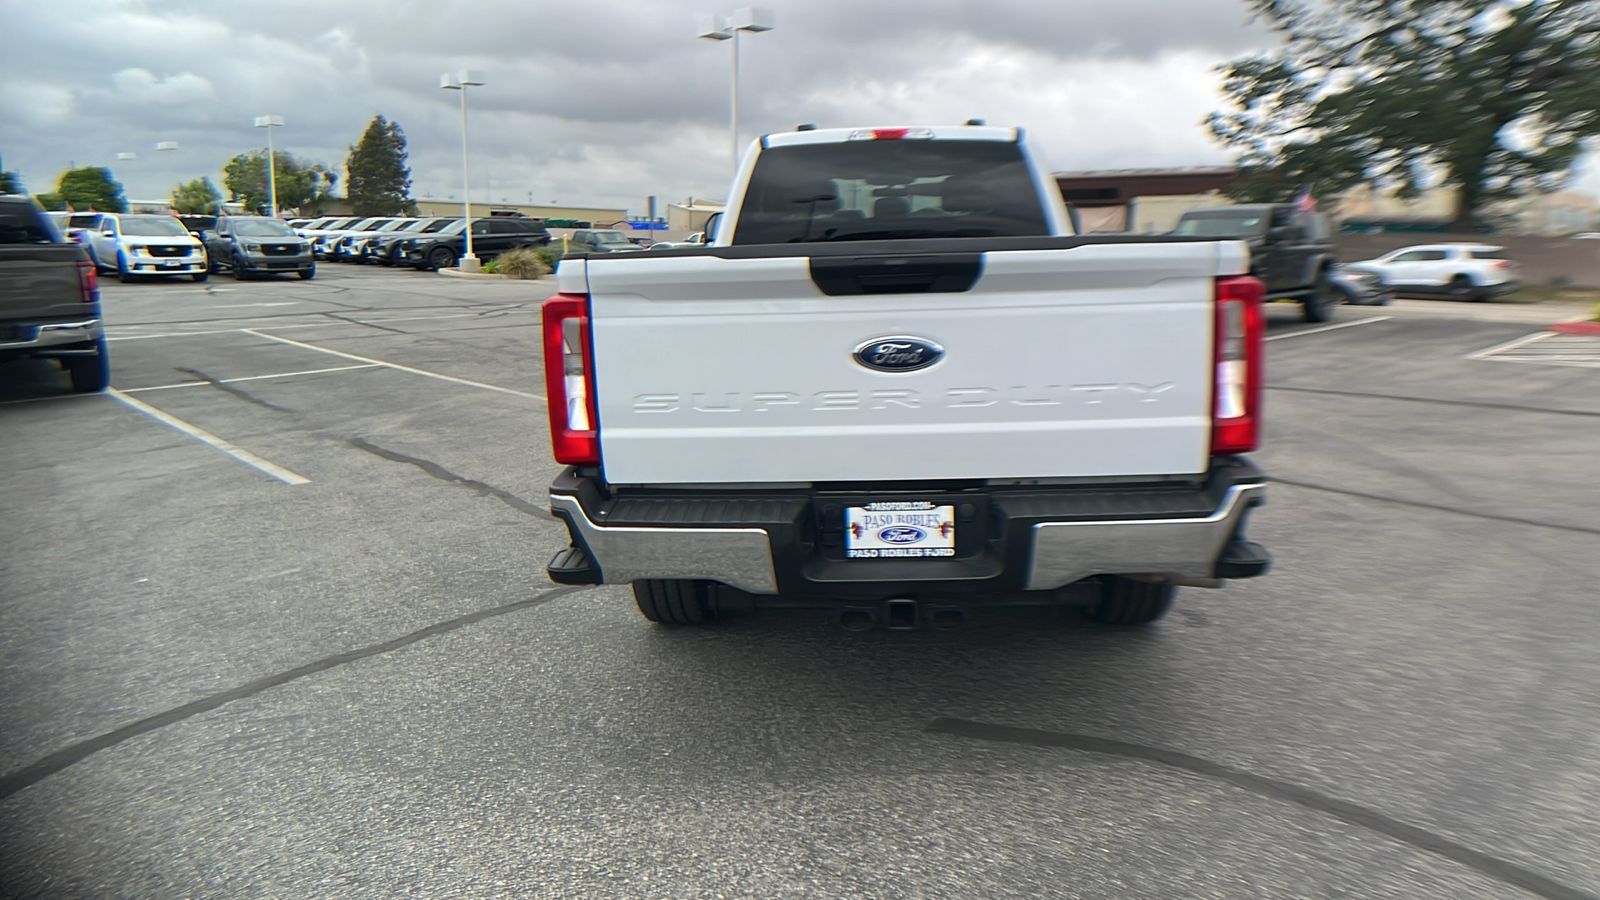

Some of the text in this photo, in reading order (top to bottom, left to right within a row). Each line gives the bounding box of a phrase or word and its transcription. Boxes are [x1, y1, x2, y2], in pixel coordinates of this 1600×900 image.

[873, 343, 924, 364] Ford
[633, 380, 1177, 414] SUPER DUTY
[863, 513, 941, 530] PASO ROBLES
[886, 529, 919, 542] Ford
[848, 548, 955, 558] PASO ROBLES FORD
